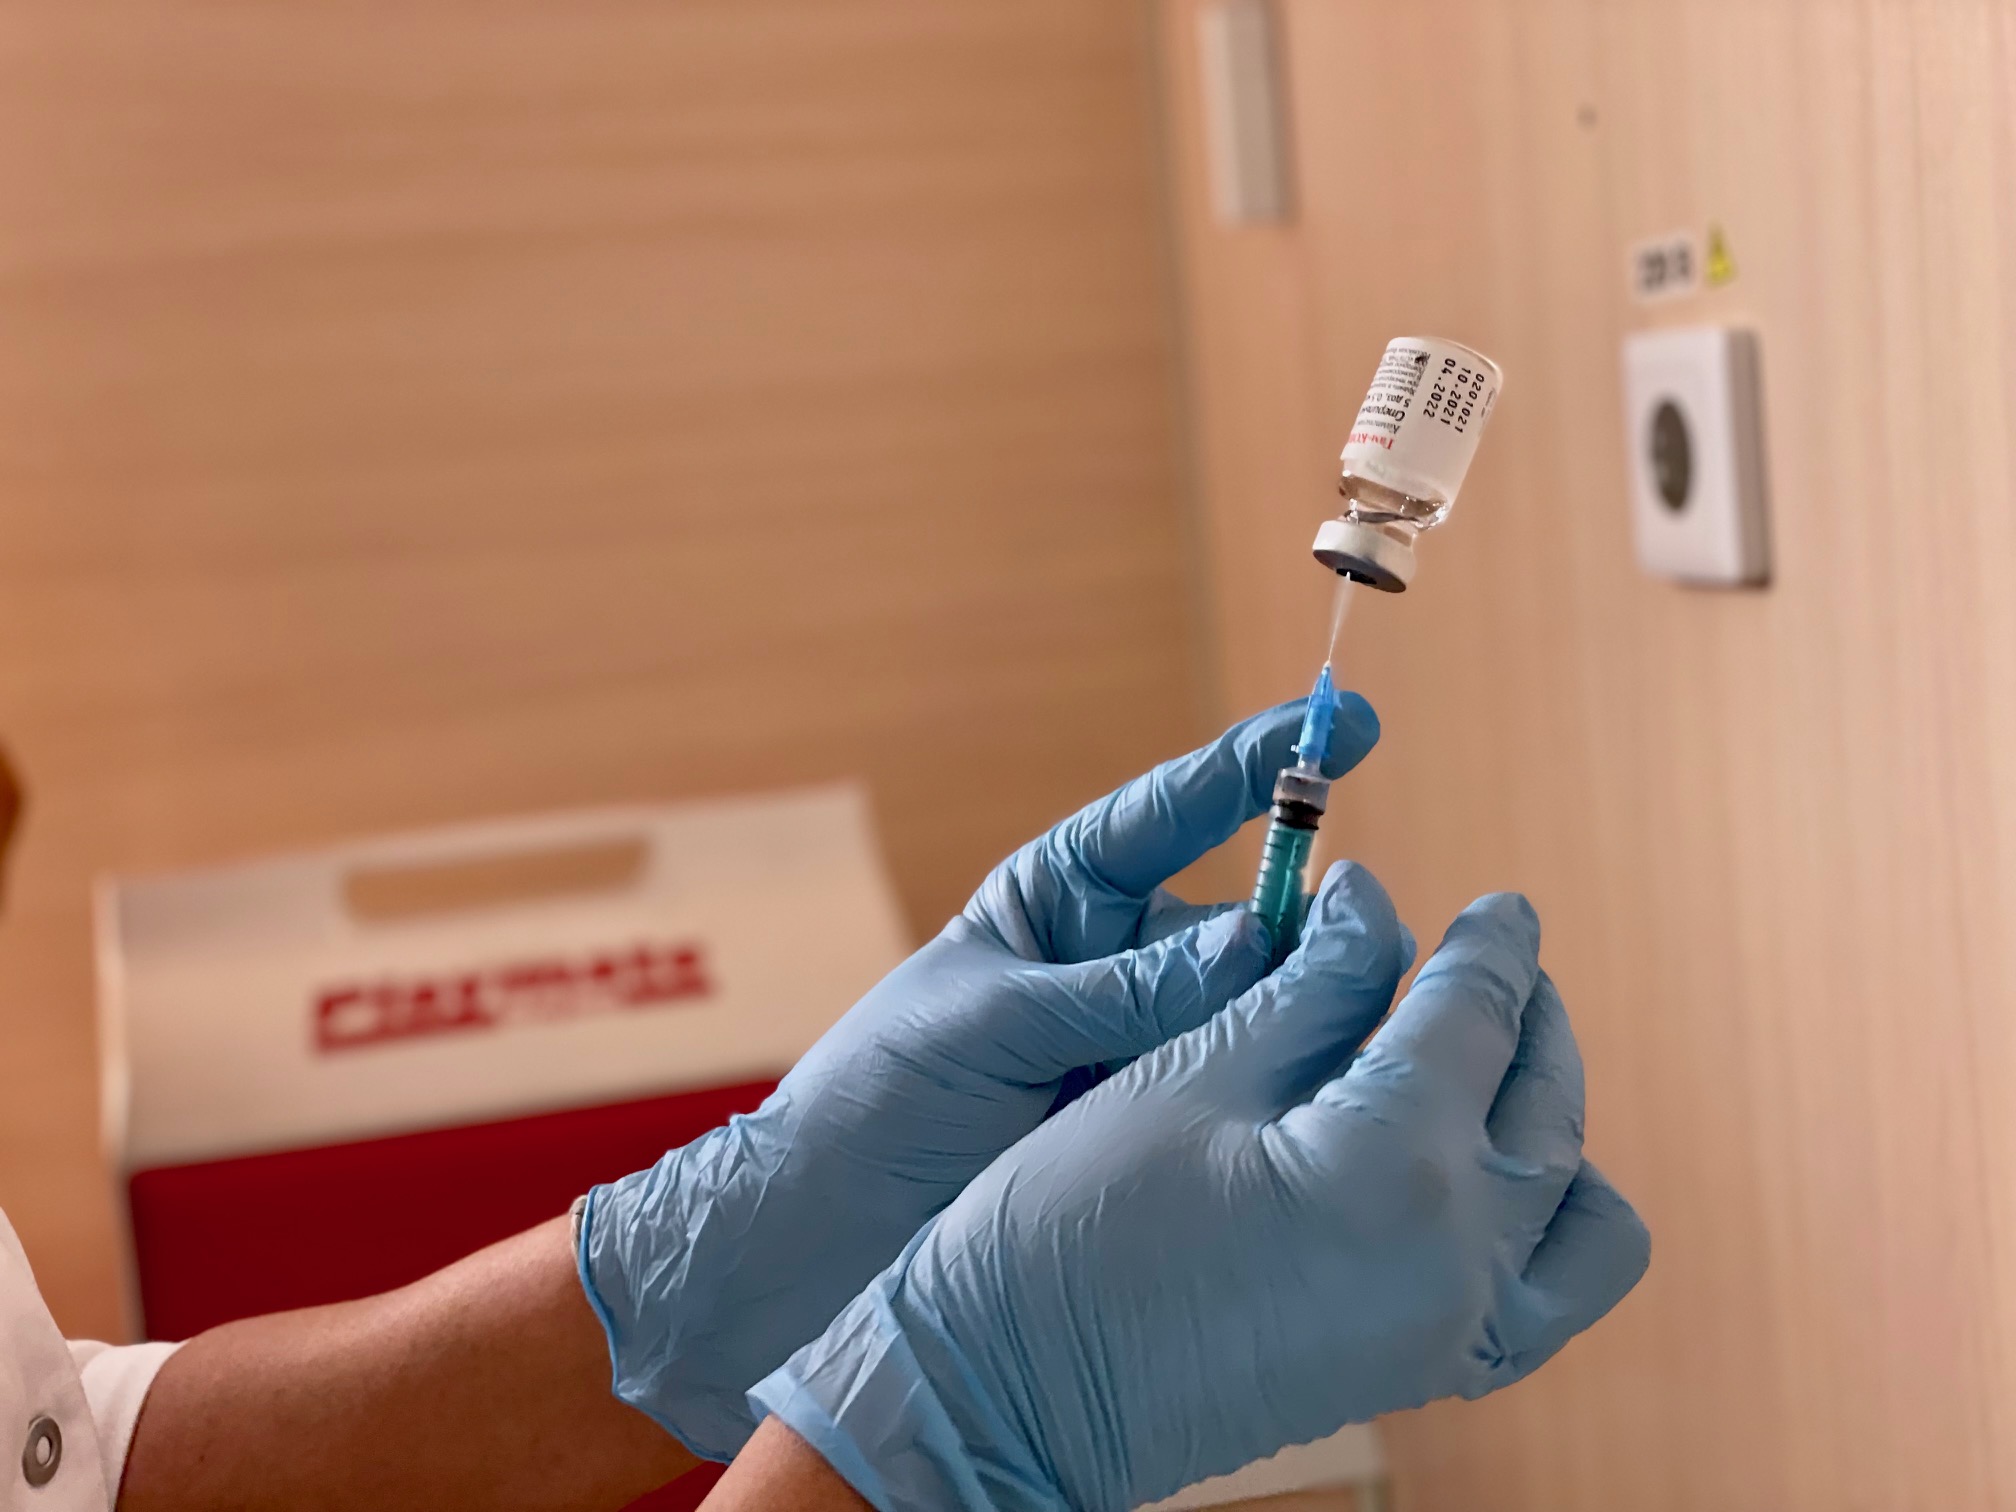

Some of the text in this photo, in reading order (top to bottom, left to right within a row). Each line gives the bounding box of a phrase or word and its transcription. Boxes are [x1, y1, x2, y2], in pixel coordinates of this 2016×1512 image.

[1403, 398, 1412, 408] 5
[1423, 358, 1456, 418] 04.2022
[1440, 367, 1471, 425] 10.2021
[1455, 374, 1485, 433] 0201021
